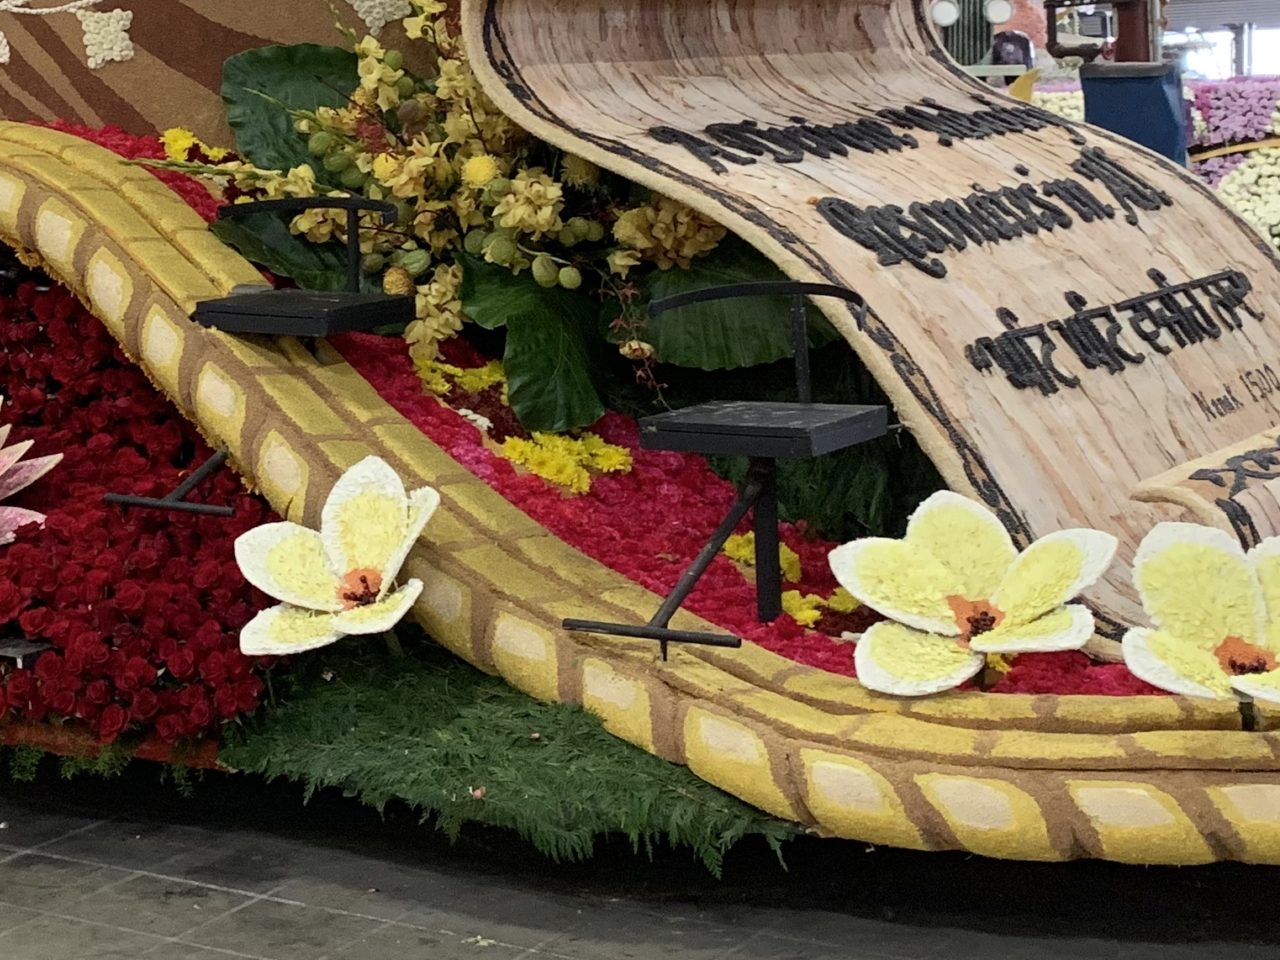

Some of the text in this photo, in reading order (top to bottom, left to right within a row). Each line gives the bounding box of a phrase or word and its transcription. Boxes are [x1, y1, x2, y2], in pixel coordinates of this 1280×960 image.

[648, 125, 757, 175] A
[817, 146, 1173, 278] Resonates in All
